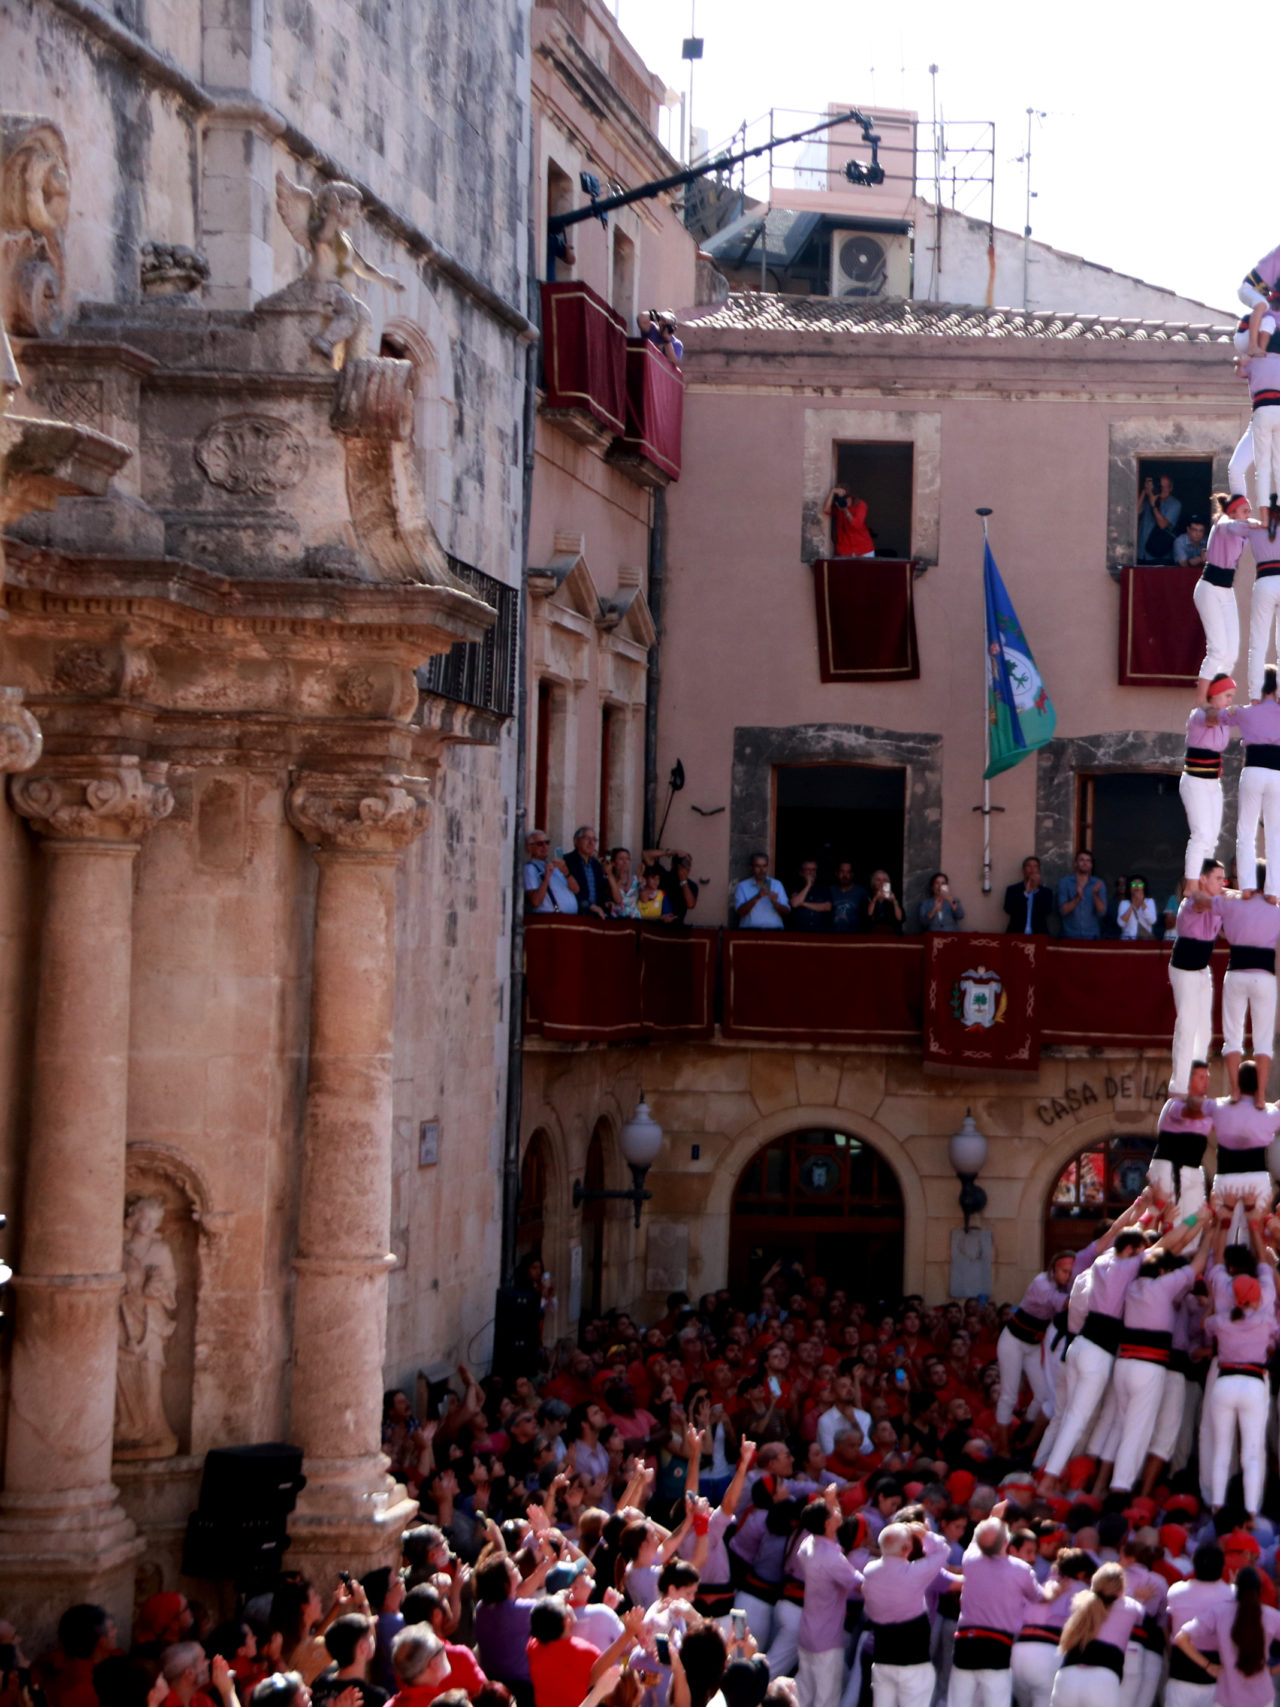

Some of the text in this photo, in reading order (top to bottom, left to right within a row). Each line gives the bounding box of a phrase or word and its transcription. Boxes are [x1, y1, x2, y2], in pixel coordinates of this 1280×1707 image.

[1036, 1075, 1168, 1126] CASA DE LA
